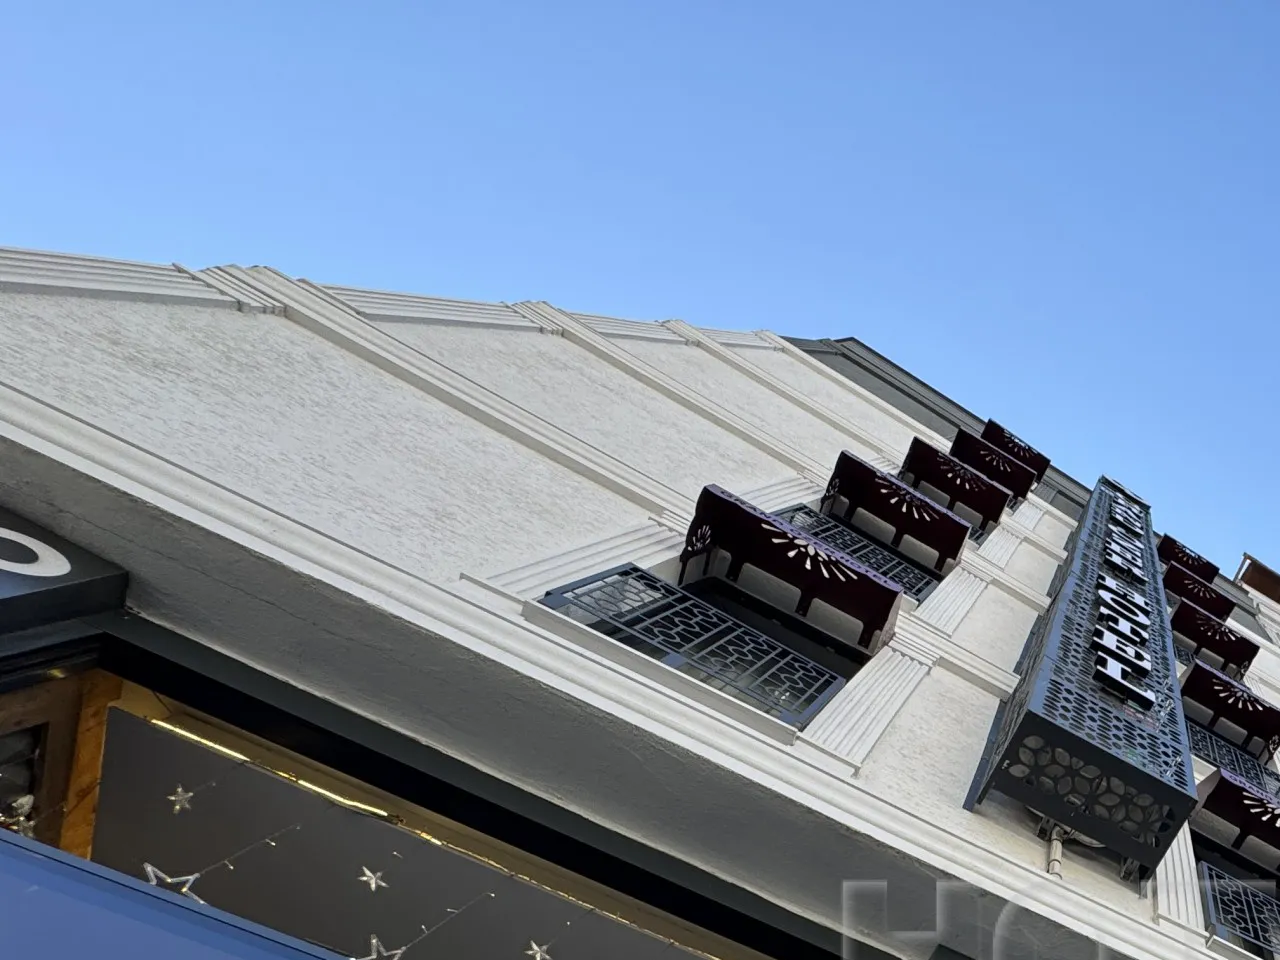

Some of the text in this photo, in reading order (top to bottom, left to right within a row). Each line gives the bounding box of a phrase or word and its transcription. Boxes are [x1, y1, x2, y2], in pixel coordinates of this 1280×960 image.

[720, 489, 784, 526] GRAND
[838, 555, 894, 586] HOTEL
[1093, 571, 1156, 702] HOTEL
[1229, 774, 1275, 802] GRAND
